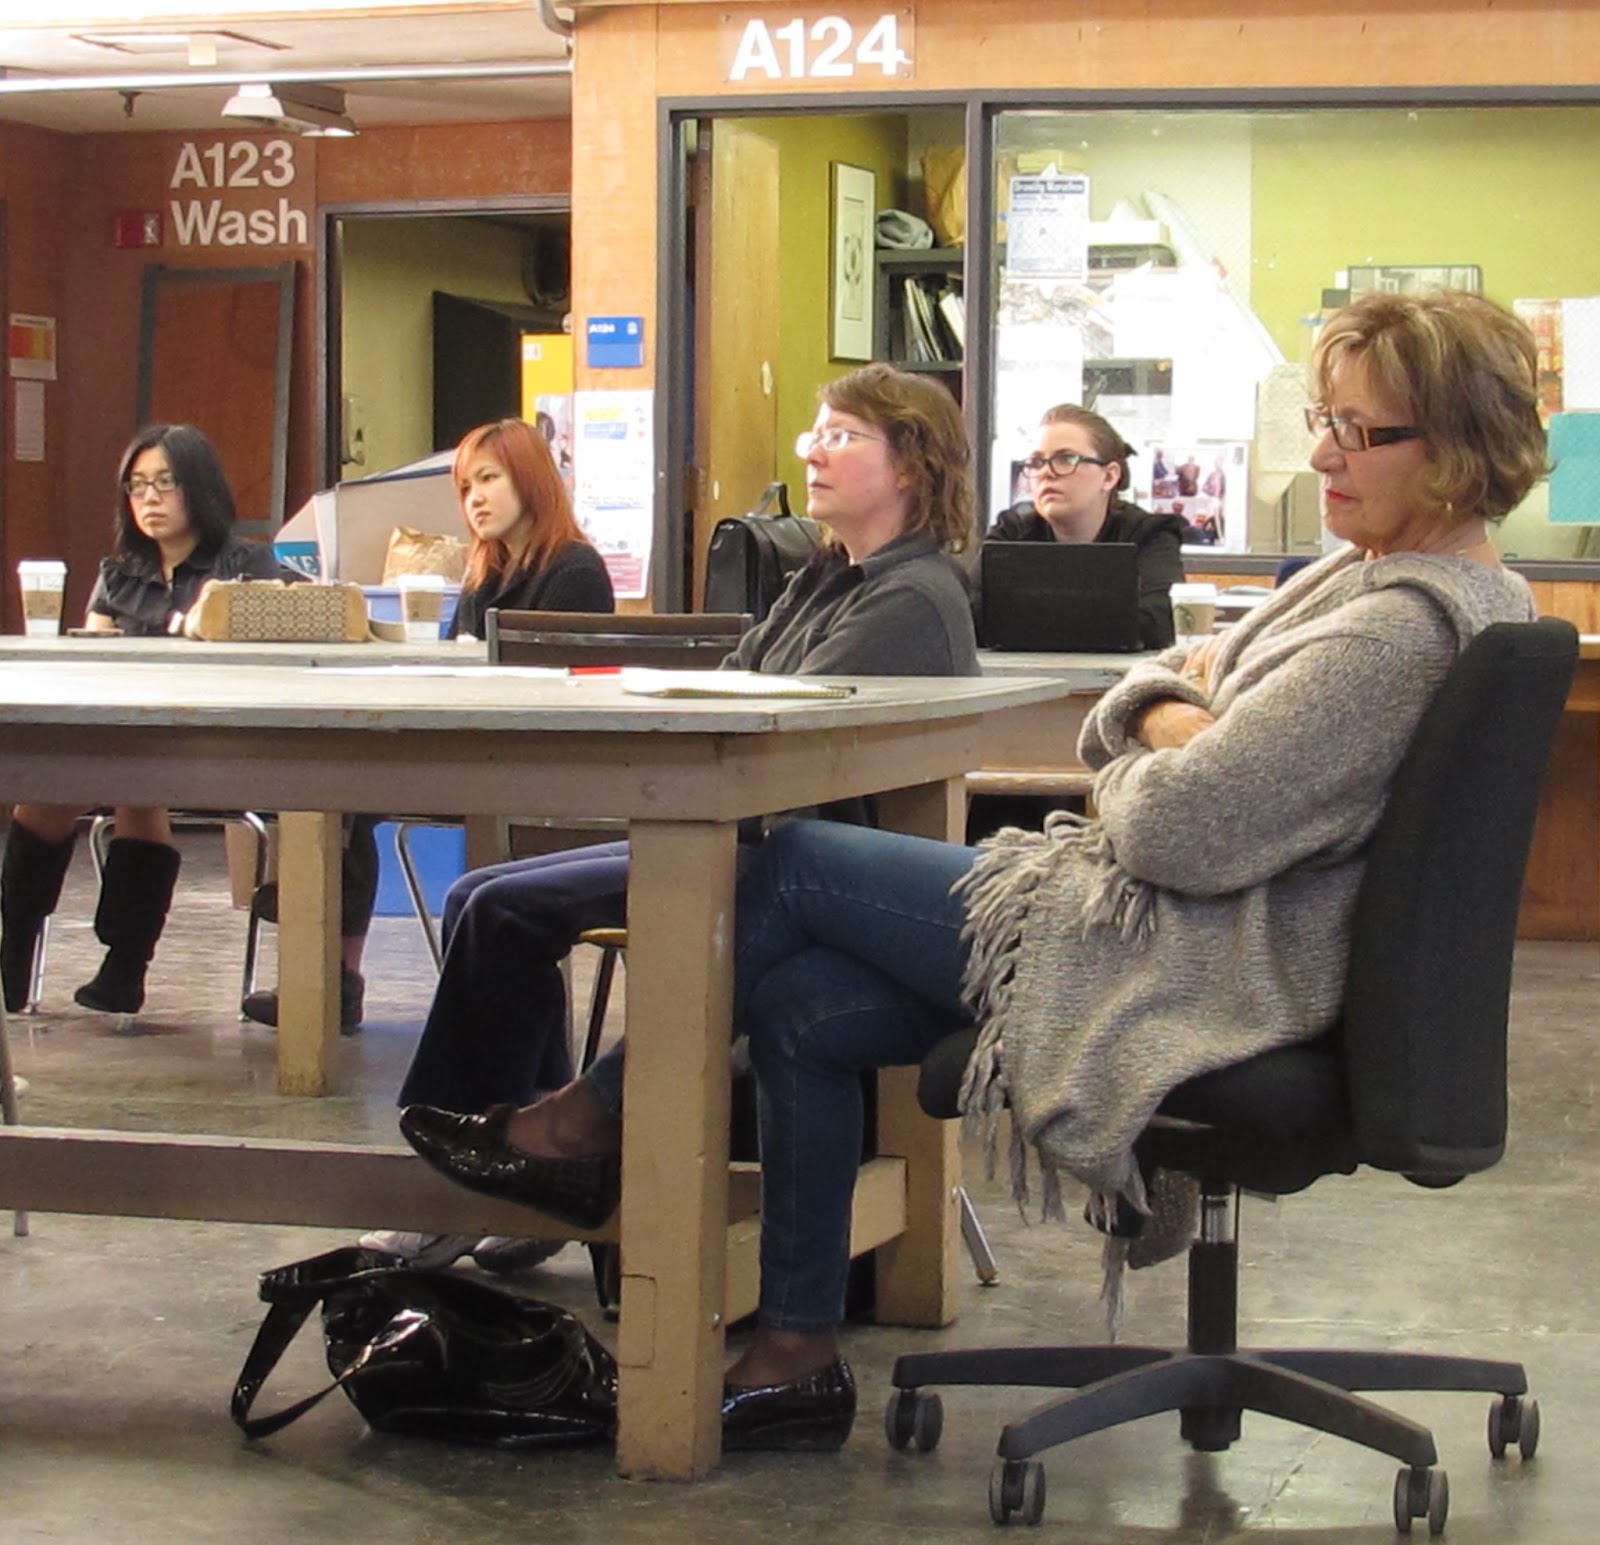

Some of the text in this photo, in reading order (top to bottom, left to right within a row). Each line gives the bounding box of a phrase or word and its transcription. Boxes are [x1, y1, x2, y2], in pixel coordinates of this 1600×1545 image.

[729, 14, 905, 80] A124
[169, 140, 296, 188] A123
[170, 198, 308, 245] Wash
